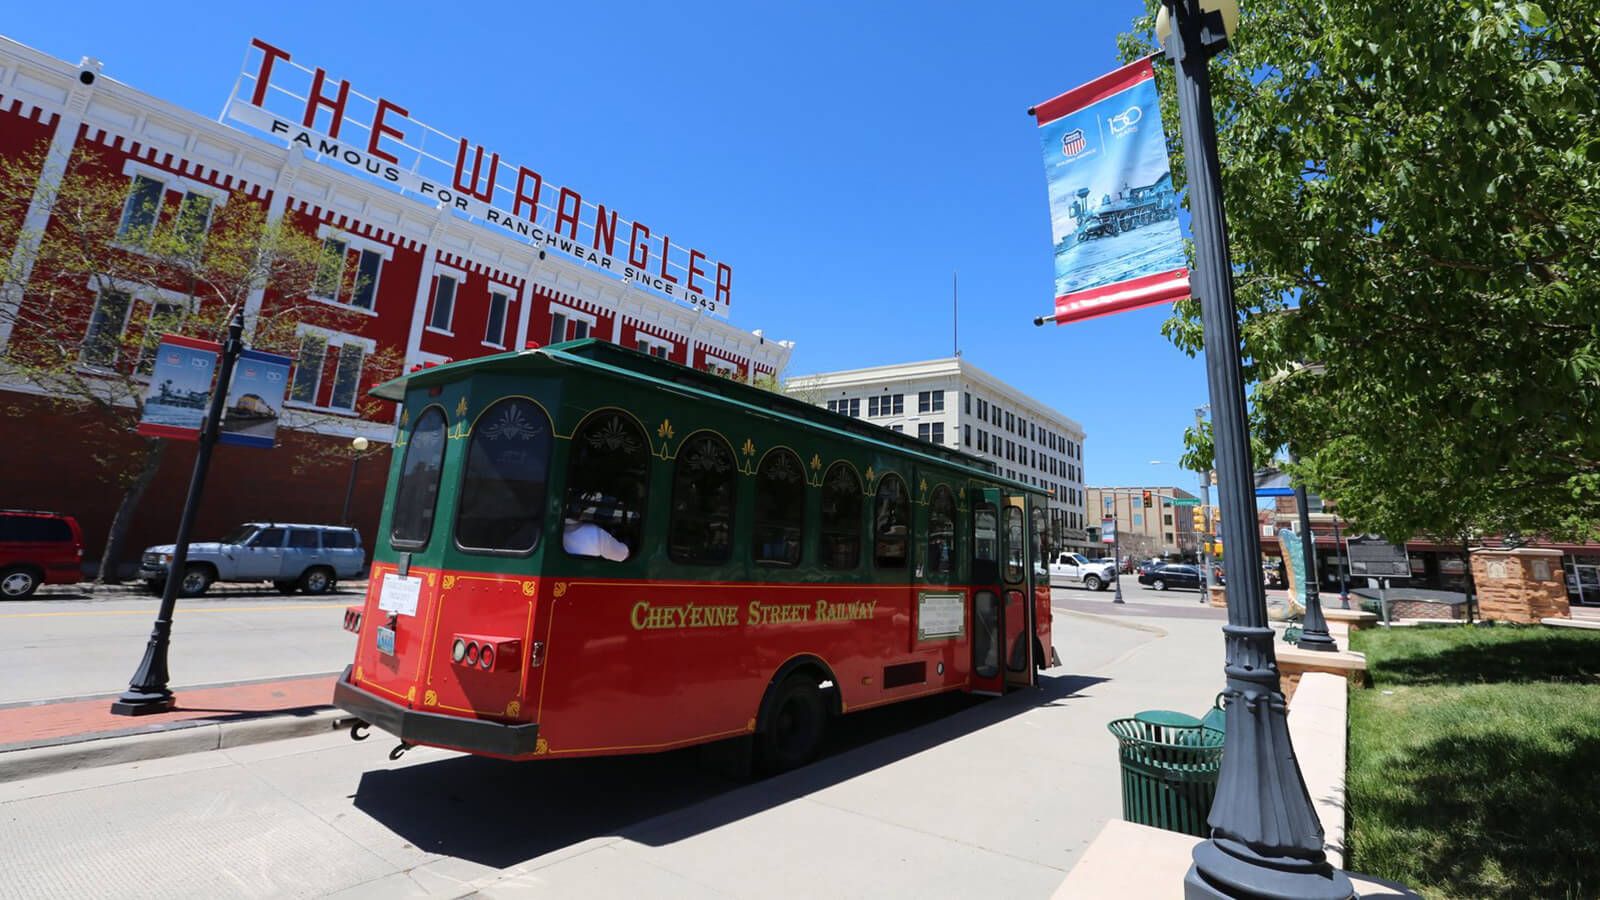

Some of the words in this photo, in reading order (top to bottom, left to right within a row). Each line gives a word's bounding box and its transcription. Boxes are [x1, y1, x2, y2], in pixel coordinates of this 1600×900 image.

[251, 37, 409, 164] THE
[452, 137, 732, 306] WRANGLER
[1107, 106, 1142, 135] 150
[271, 120, 399, 182] FAMOUS
[420, 182, 468, 211] FOR
[486, 209, 612, 269] RANCHWEAR
[624, 267, 674, 295] SINCE
[684, 291, 716, 312] 1943
[630, 601, 740, 631] CHEYENNE
[746, 600, 812, 628] STREET
[815, 599, 877, 622] RAILWAY
